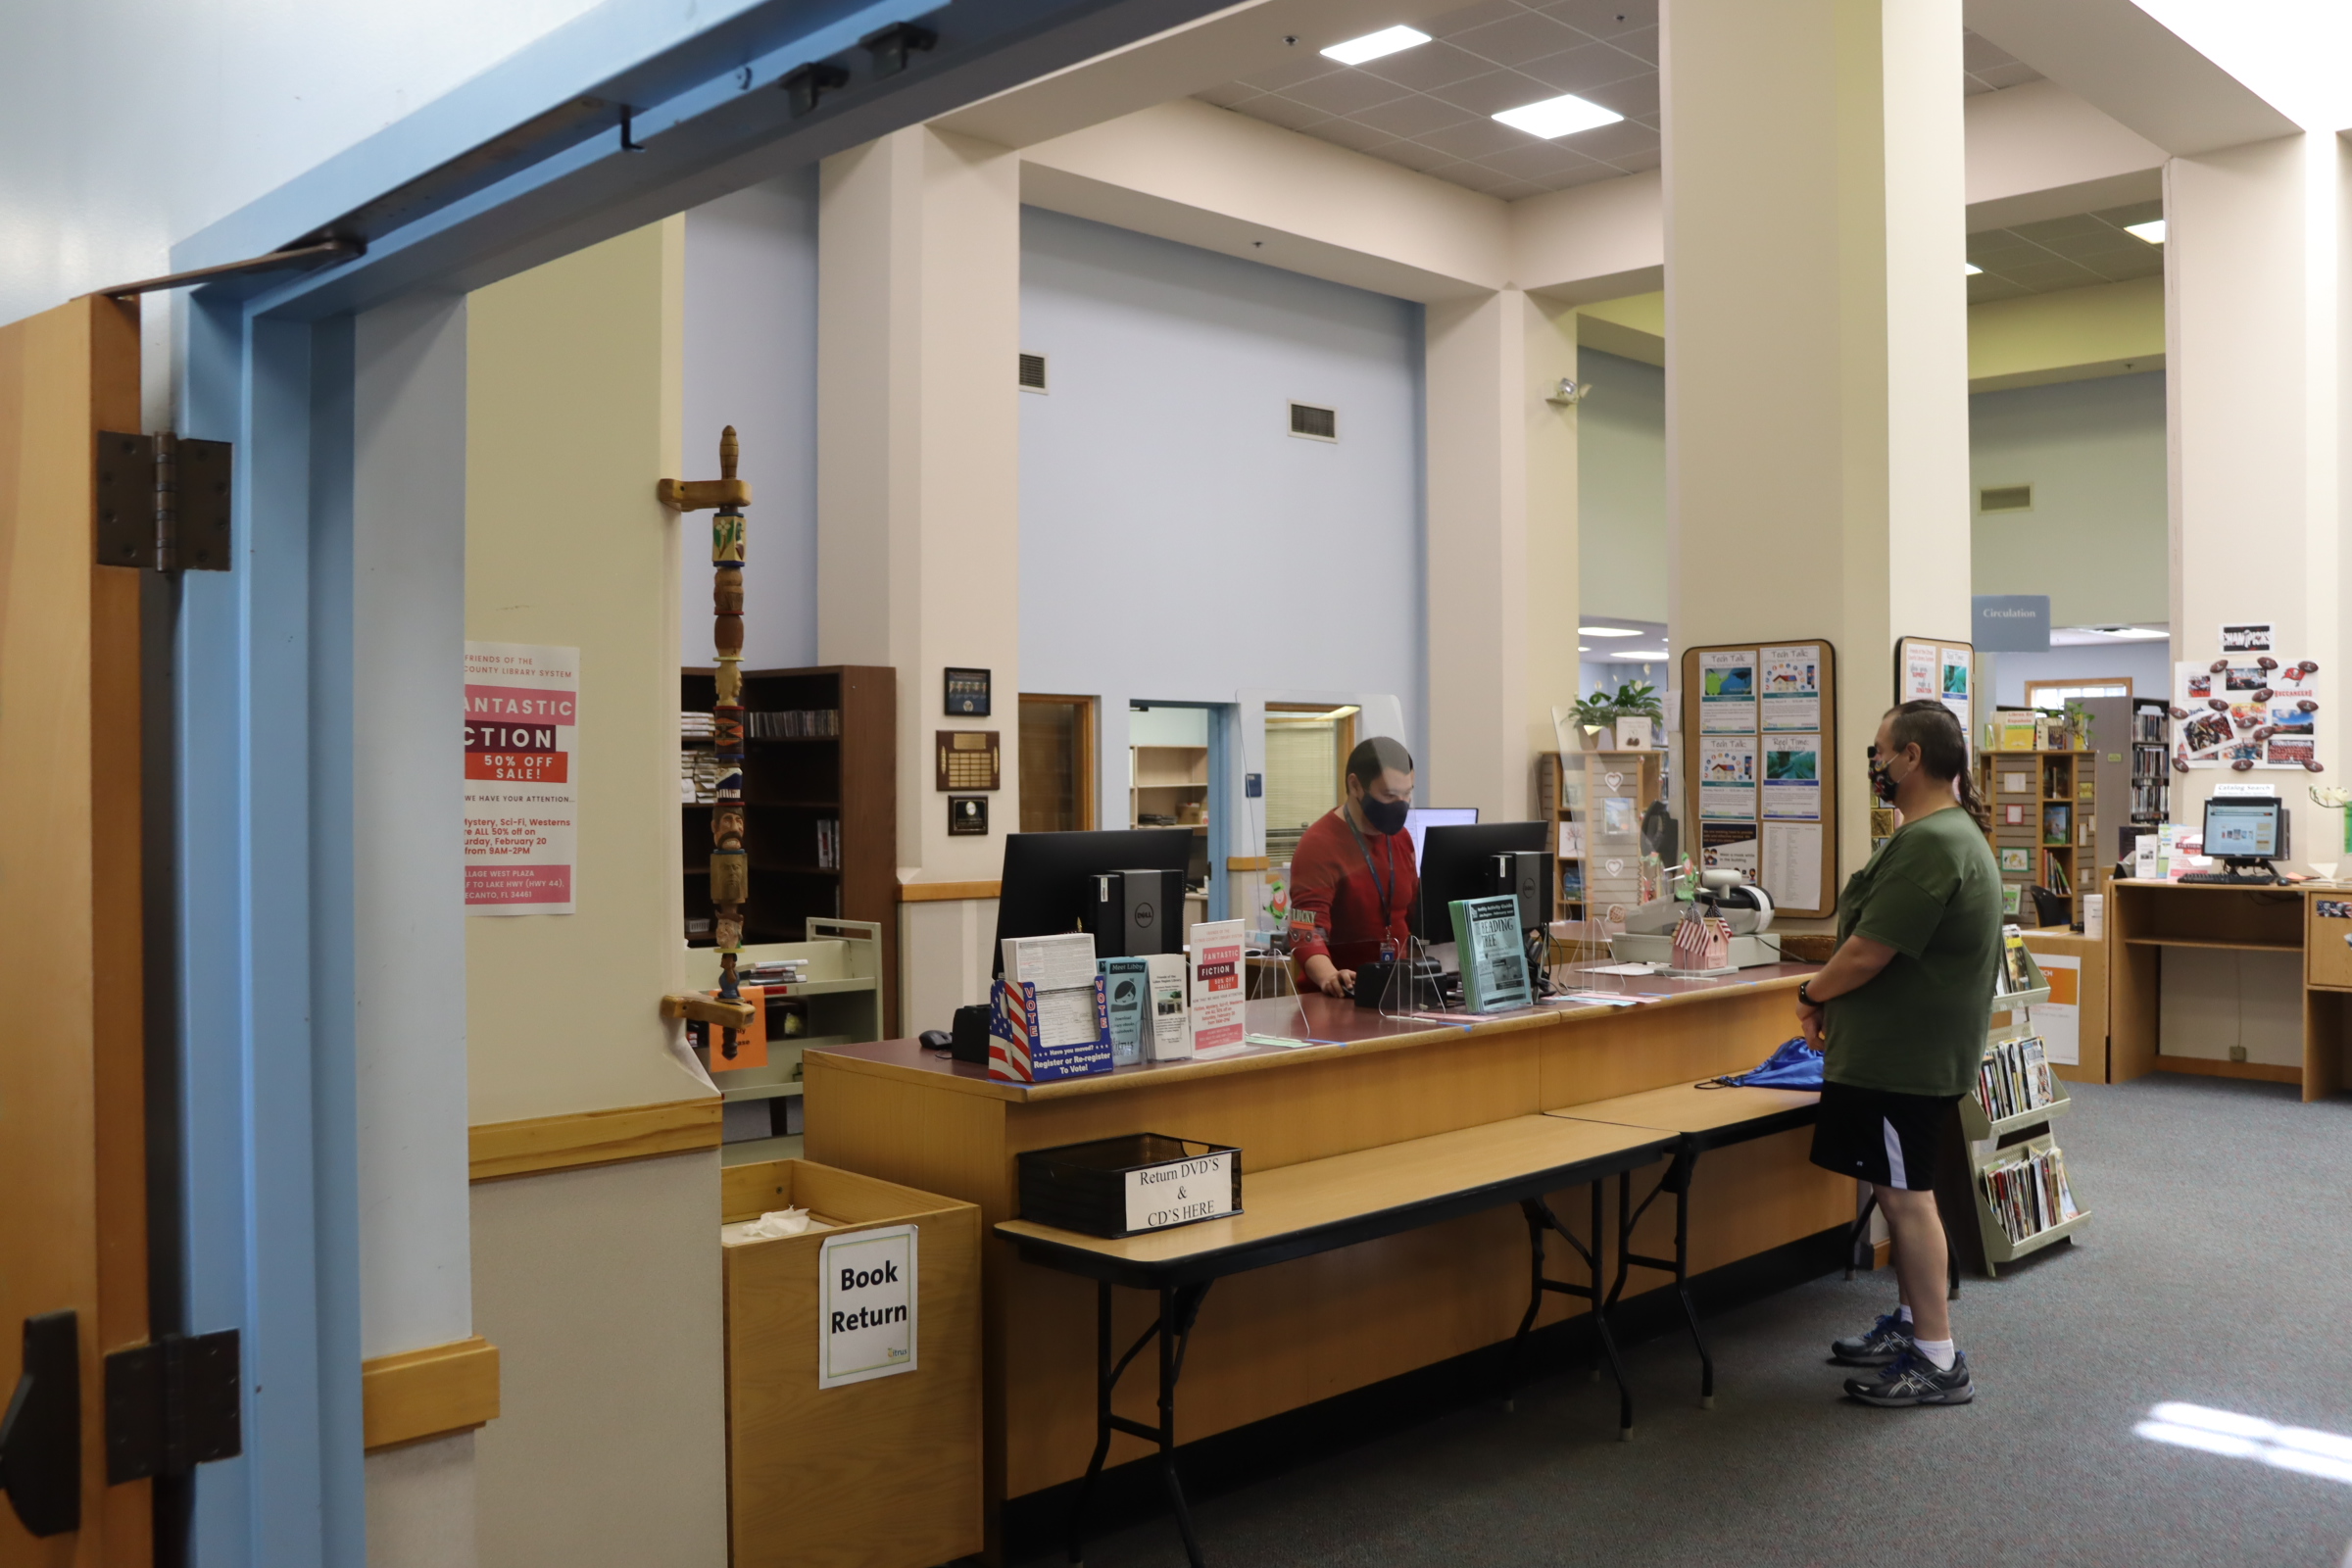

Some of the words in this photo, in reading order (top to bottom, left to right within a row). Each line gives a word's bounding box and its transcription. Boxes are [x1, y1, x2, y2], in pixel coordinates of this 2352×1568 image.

[1983, 608, 2035, 618] Circulation
[484, 756, 515, 766] 50%
[524, 757, 553, 766] OFF
[496, 768, 541, 779] SALE!
[501, 818, 527, 827] Sci-Fi,
[495, 838, 534, 847] February
[525, 878, 546, 888] (HWY
[1293, 908, 1316, 923] LUCKY
[1481, 918, 1513, 934] READING
[1482, 934, 1496, 948] TREE
[1203, 950, 1239, 960] FANTASTIC
[1201, 965, 1230, 976] FICTION
[1096, 980, 1107, 1029] VOTE
[1024, 987, 1039, 1037] VOTE
[1034, 1059, 1063, 1069] Register
[1073, 1053, 1110, 1063] Re-register
[1070, 1064, 1088, 1073] Vote!
[1140, 1168, 1177, 1186] Return
[1177, 1186, 1188, 1200] &
[1182, 1200, 1215, 1221] HERE
[841, 1259, 899, 1292] Book
[831, 1304, 907, 1335] Return
